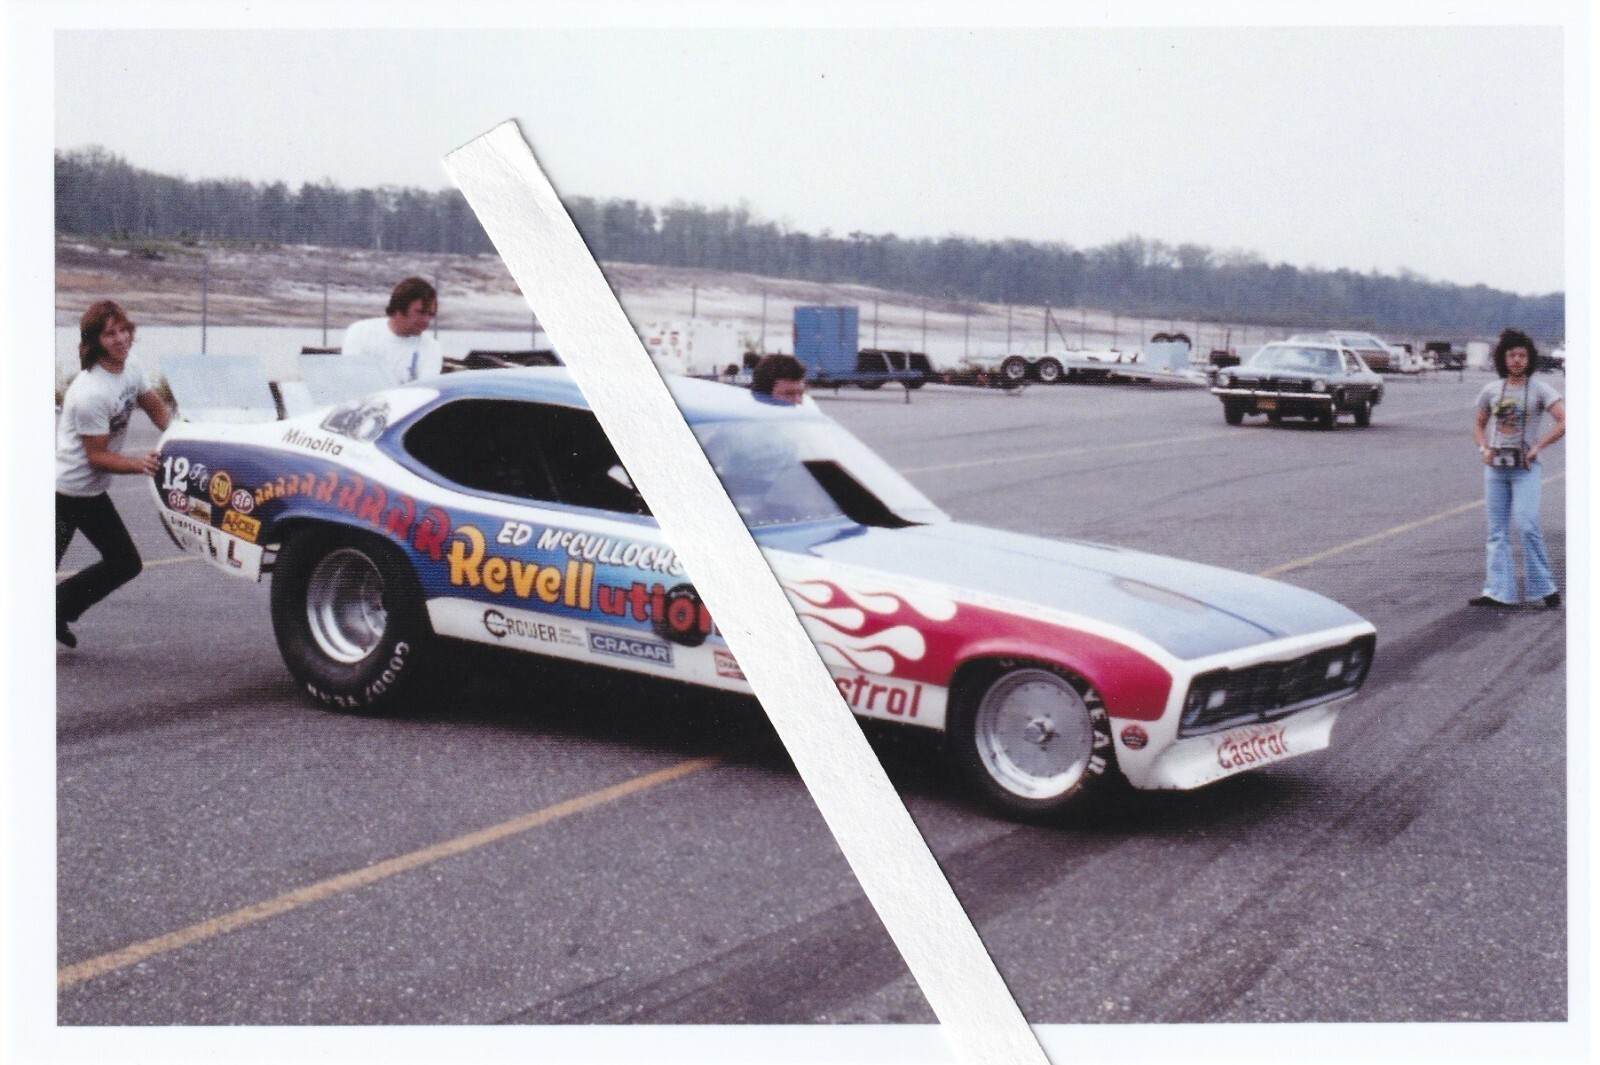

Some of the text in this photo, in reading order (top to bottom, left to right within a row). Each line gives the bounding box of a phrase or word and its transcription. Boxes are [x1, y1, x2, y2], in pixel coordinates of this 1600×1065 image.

[282, 429, 344, 455] Minolta
[162, 457, 190, 491] 12
[233, 491, 253, 510] STP
[497, 521, 533, 545] ED
[483, 609, 558, 642] CROWER
[593, 636, 668, 661] CRAGAR
[1217, 726, 1289, 769] Castrol
